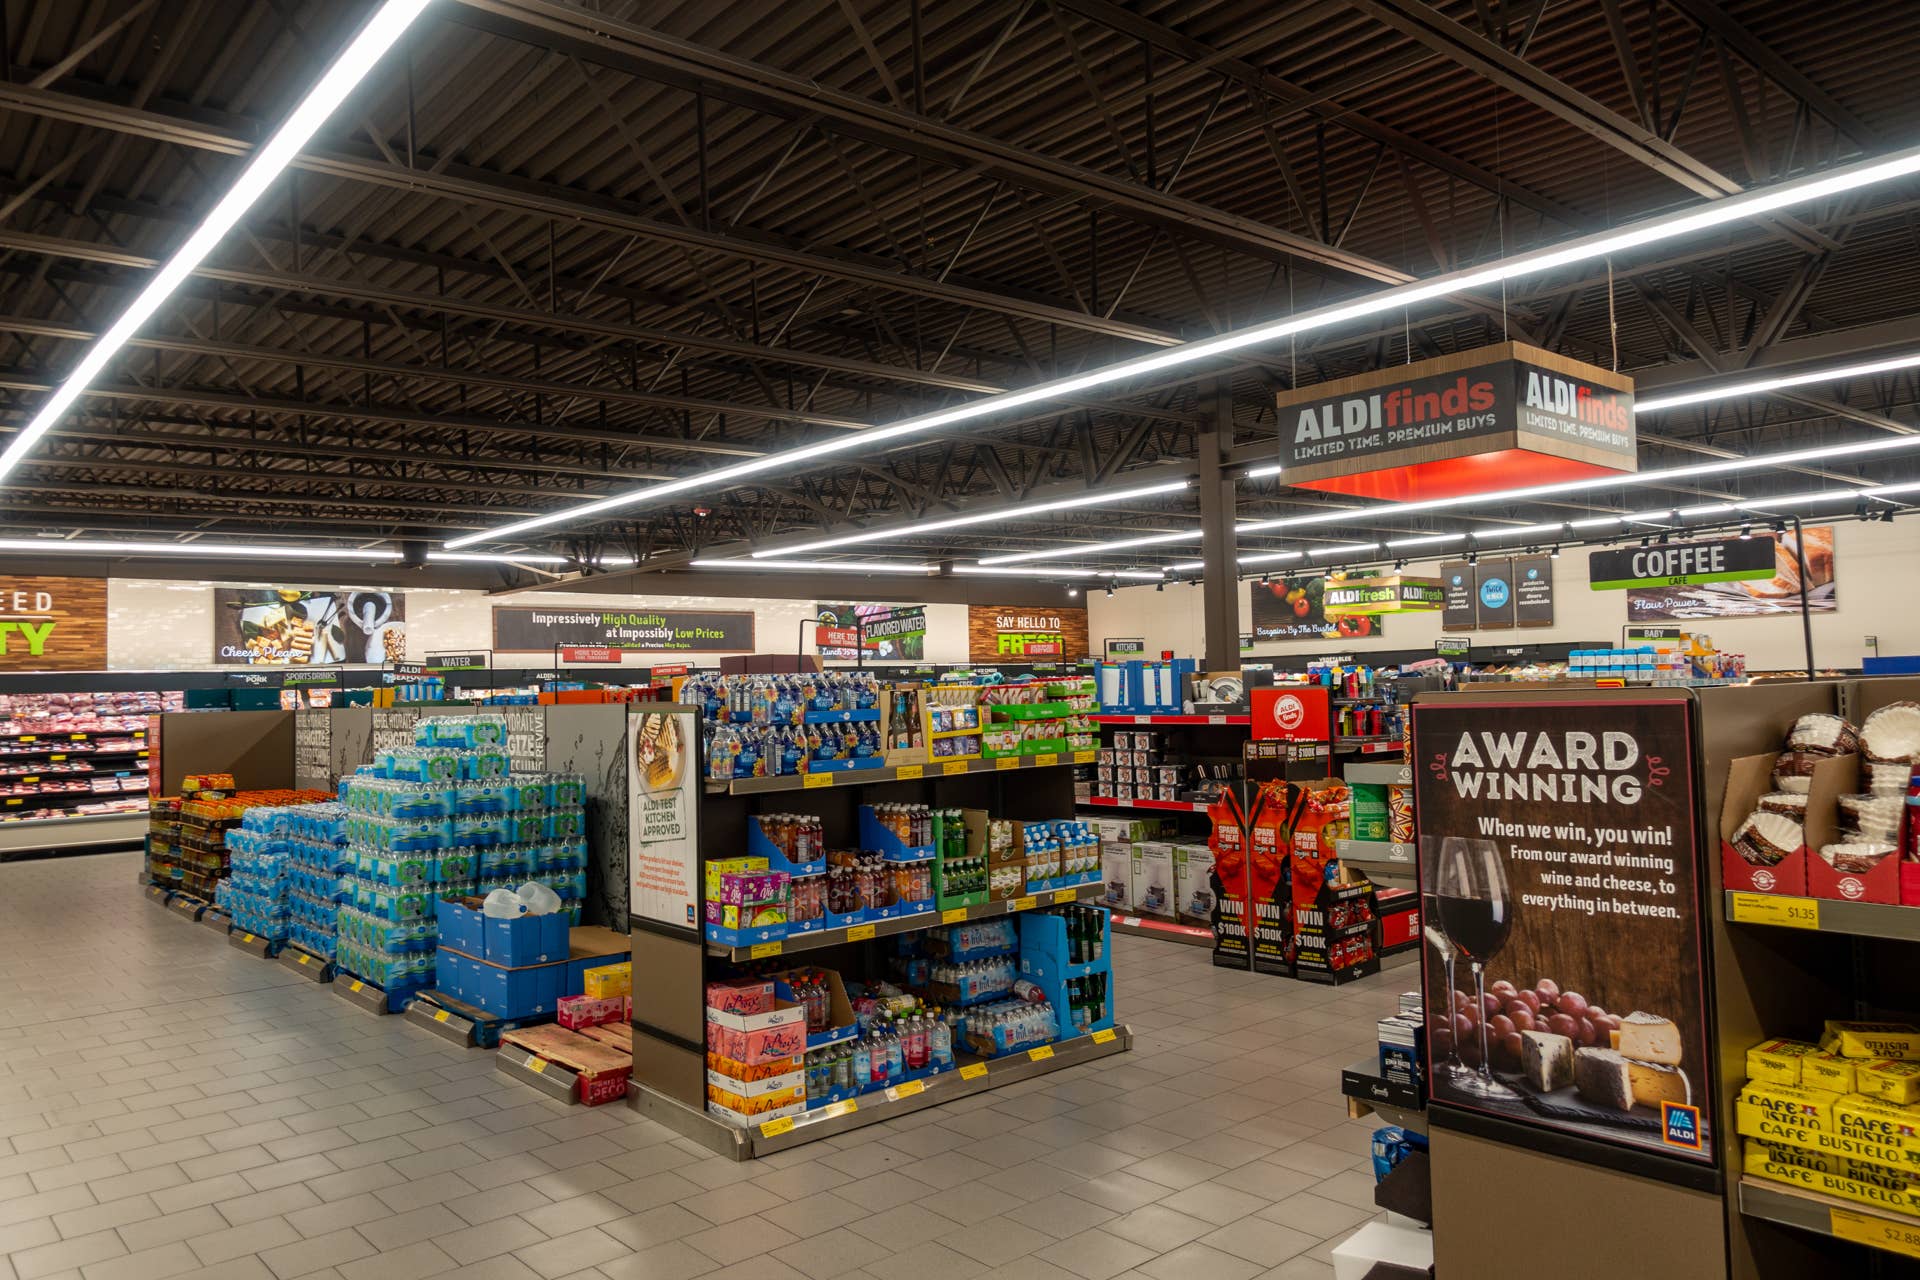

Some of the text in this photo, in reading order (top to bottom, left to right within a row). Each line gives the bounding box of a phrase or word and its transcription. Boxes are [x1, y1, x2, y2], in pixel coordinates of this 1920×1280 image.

[1526, 372, 1628, 432] ALDIfinds
[1295, 377, 1496, 444] ALDIfinds
[1294, 413, 1497, 461] LIMITED TIME, PREMIUM BUYS
[1526, 412, 1558, 431] LIMITED
[1579, 424, 1612, 443] PREMIUM
[1612, 432, 1630, 449] BUYS
[1632, 545, 1725, 578] COFFEE
[1330, 587, 1395, 604] ALDIfresh
[1403, 586, 1443, 601] ALDIfresh
[1634, 597, 1700, 610] Flour Power
[532, 612, 667, 628] Impressively High Quality
[865, 619, 901, 638] FLAVORED
[900, 616, 926, 632] WATER
[996, 616, 1060, 629] SAY HELLO TO
[606, 627, 725, 642] at Impossibly Low Prices
[828, 631, 846, 640] HERE
[1256, 622, 1338, 637] Bargains By The Bushel
[1644, 629, 1664, 638] BABY
[221, 646, 304, 658] Cheese Please
[821, 647, 841, 656] Lunch
[1115, 642, 1137, 652] KITCHEN
[441, 657, 471, 667] WATER
[245, 675, 268, 683] PORK
[285, 672, 337, 681] SPORTS DRINKS
[1280, 704, 1295, 713] ALDI
[373, 730, 413, 748] ENERGIZE
[536, 712, 544, 758] REVIVE
[1451, 731, 1640, 771] AWARD
[1451, 771, 1642, 805] WINNING
[643, 797, 677, 811] ALDI TEST
[645, 810, 676, 823] KITCHEN
[643, 823, 681, 837] APPROVED
[1218, 825, 1239, 835] SPARK
[1254, 827, 1275, 837] SPARK
[1294, 832, 1317, 841] SPARK
[1477, 816, 1673, 848] When we win, you win!
[1225, 834, 1239, 842] BEAT
[1261, 837, 1275, 845] BEAT
[1302, 841, 1317, 850] BEAT
[1510, 845, 1674, 875] From our award winning
[1541, 871, 1676, 896] wine and cheese, to
[1219, 899, 1244, 915] WIN
[1255, 903, 1280, 919] WIN
[1522, 893, 1681, 919] everything in between.
[1787, 906, 1816, 920] $1.35
[1296, 909, 1324, 926] WIN
[1218, 922, 1246, 937] $100K
[1254, 926, 1282, 943] $100K
[1295, 934, 1326, 949] $100K
[760, 1032, 801, 1056] LaCroix
[1865, 1040, 1910, 1051] BUSTELO
[1669, 1128, 1694, 1140] ALDI
[1818, 1135, 1900, 1163] BUSTELO
[1823, 1176, 1904, 1205] BUSTELO
